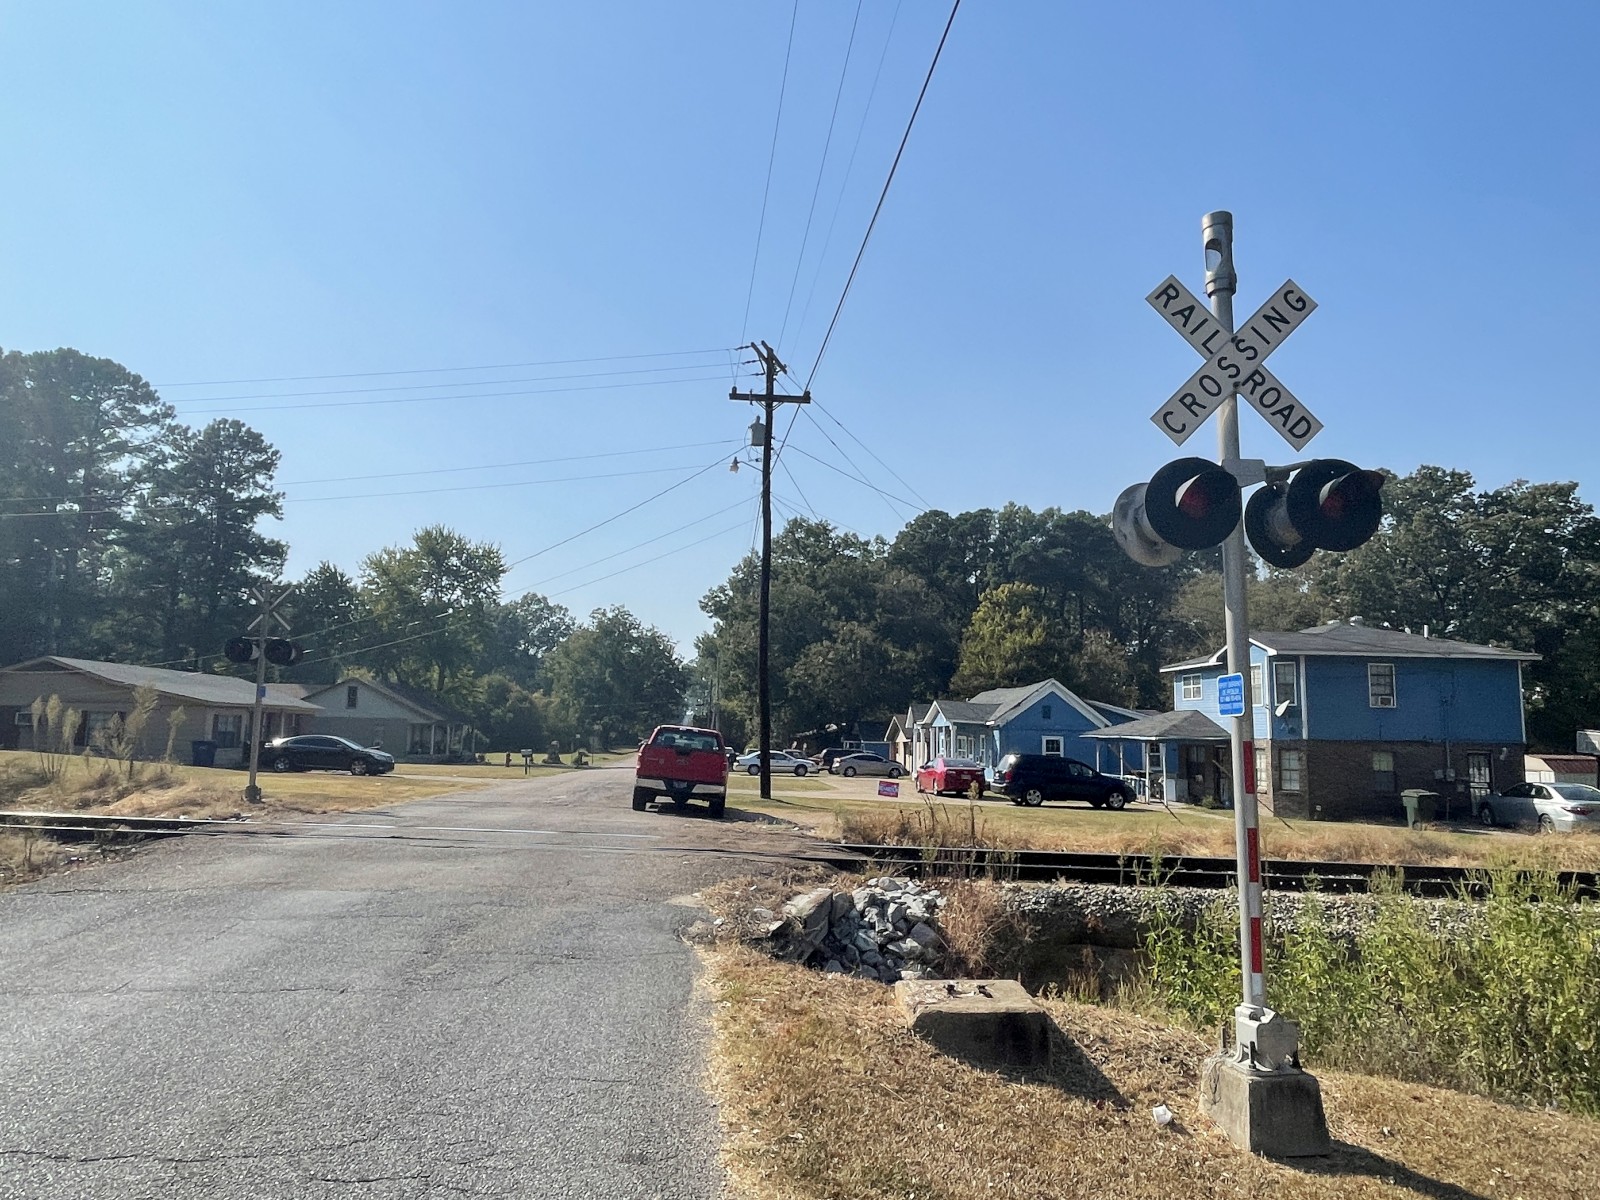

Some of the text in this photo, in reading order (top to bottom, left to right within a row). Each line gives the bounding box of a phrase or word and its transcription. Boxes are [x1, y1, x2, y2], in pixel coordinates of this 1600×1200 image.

[1155, 283, 1312, 439] RAIL ROAD
[1162, 289, 1307, 435] CROSSING
